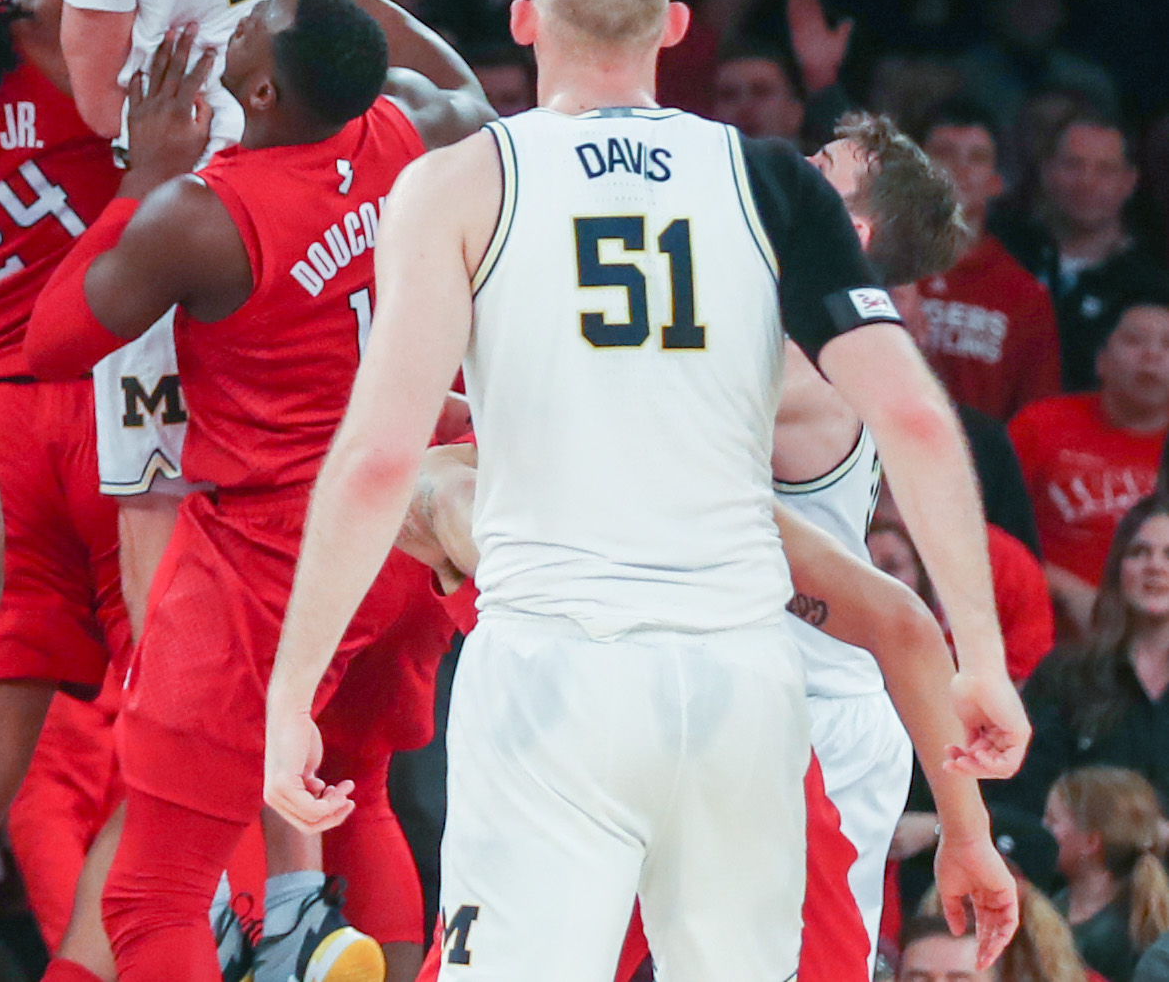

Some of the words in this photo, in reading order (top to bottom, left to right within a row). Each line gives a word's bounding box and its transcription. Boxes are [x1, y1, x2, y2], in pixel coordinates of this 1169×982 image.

[0, 101, 44, 150] JR.
[574, 137, 673, 183] DAVIS
[289, 197, 387, 298] DOUCO
[572, 215, 707, 351] 51
[121, 375, 188, 427] M
